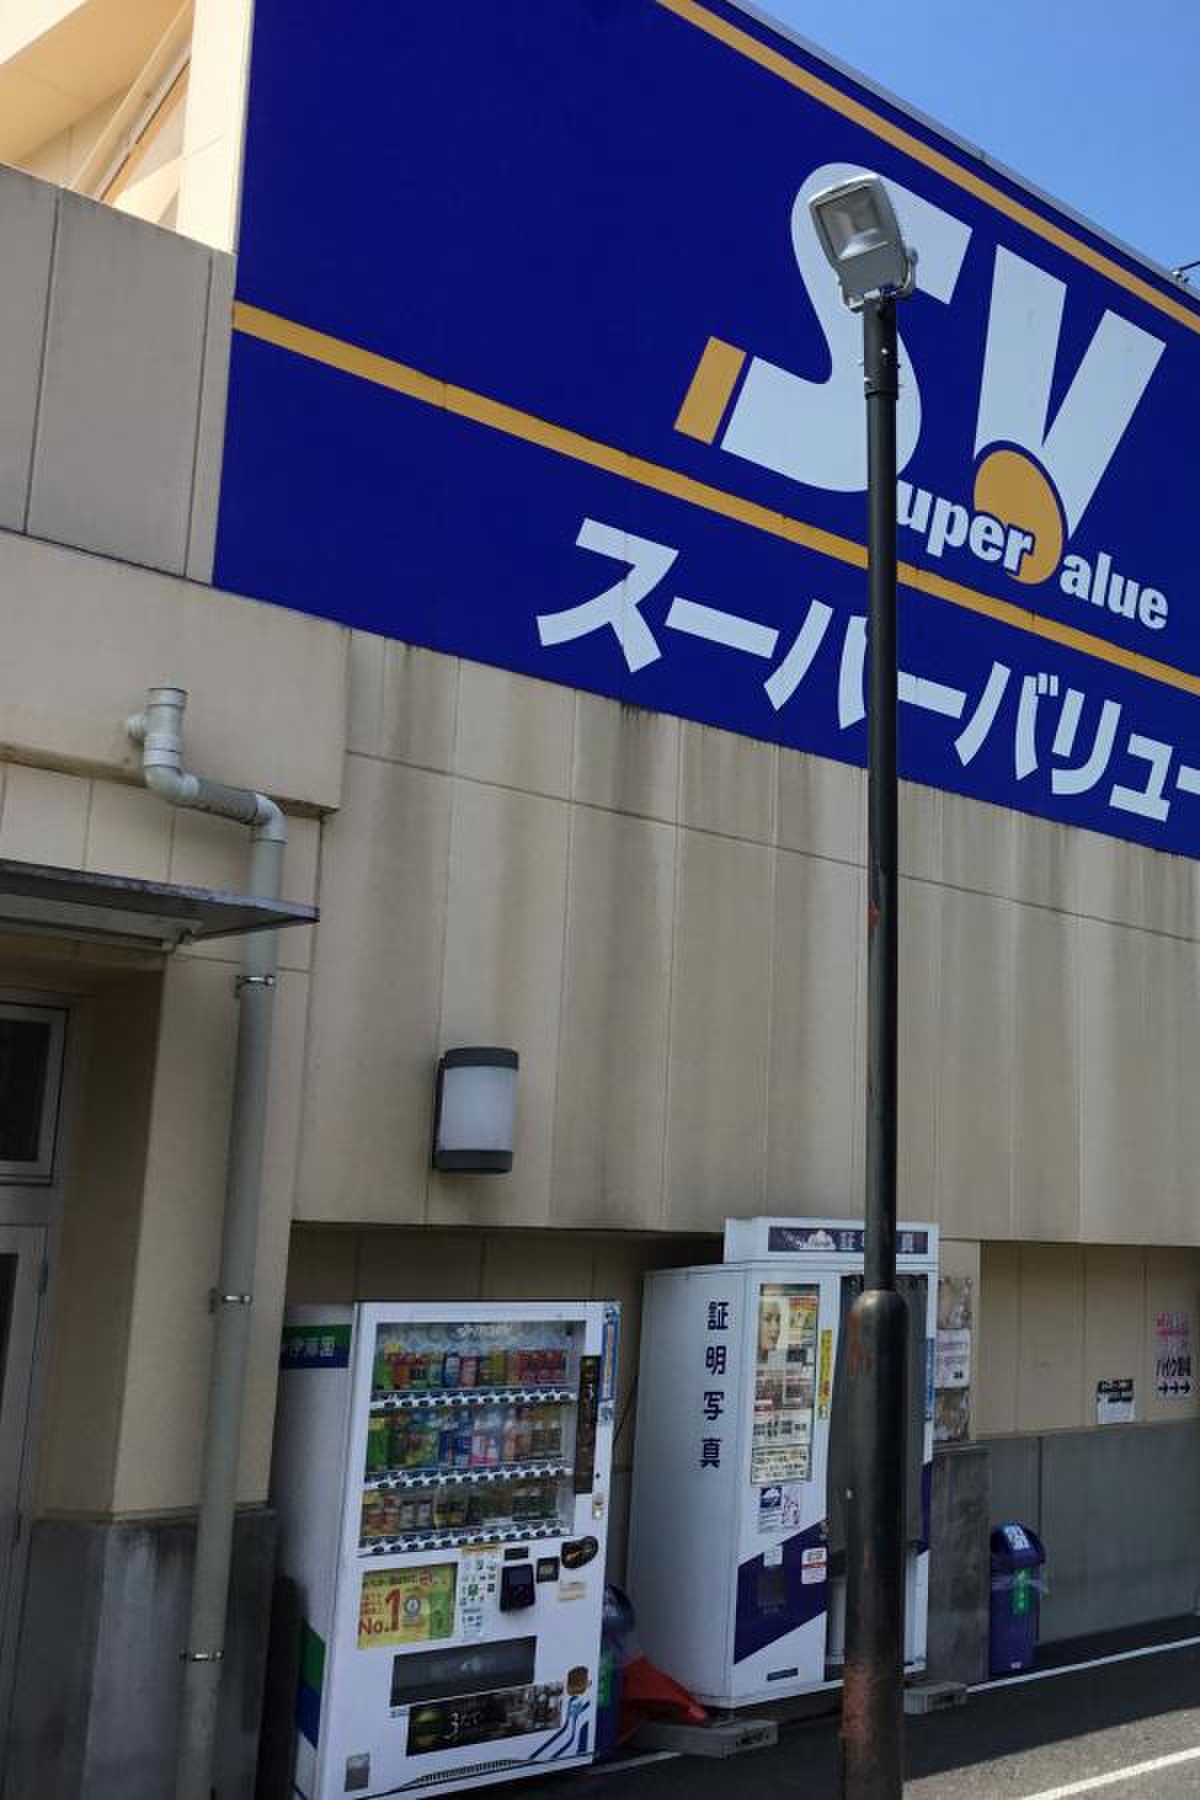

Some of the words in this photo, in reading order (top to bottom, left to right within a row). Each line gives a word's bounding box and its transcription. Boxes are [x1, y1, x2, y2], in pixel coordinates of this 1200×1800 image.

[1060, 552, 1169, 630] alue
[700, 1301, 729, 1468] 証明写真
[360, 1588, 400, 1634] No.1
